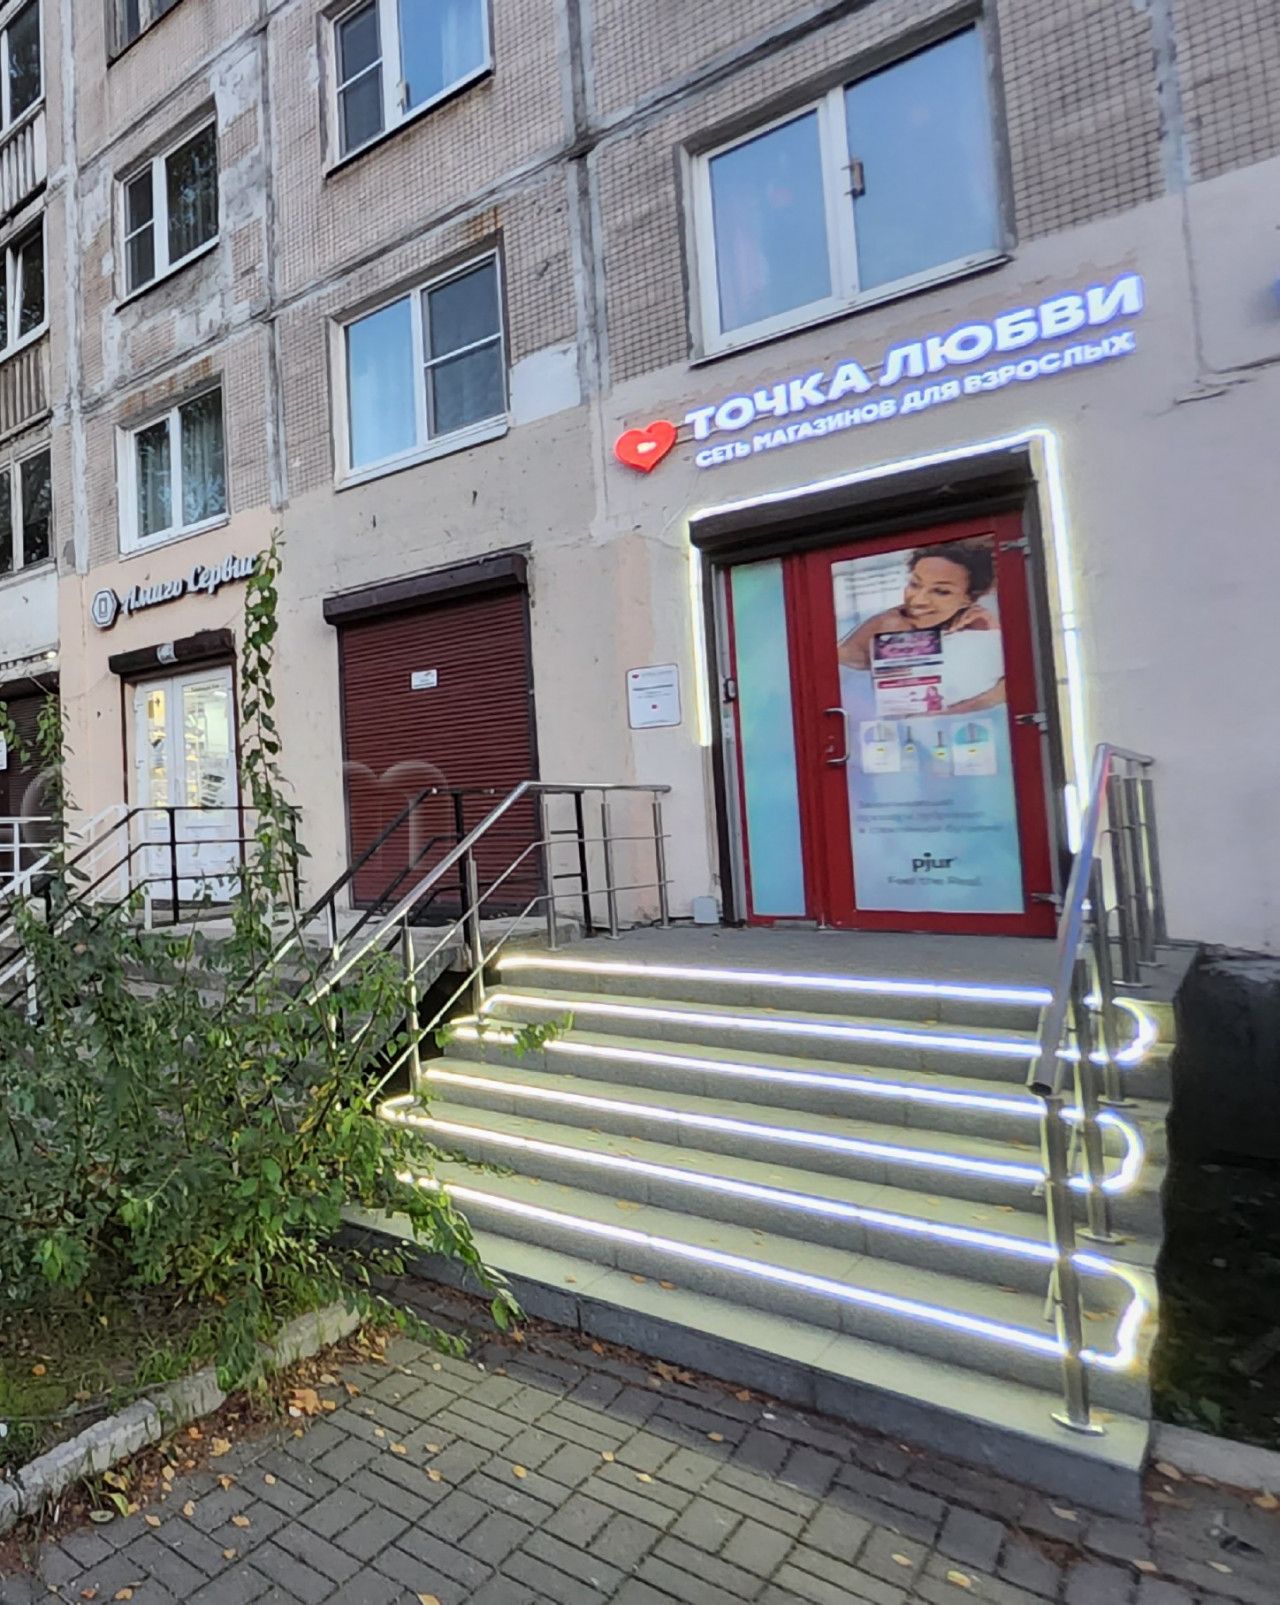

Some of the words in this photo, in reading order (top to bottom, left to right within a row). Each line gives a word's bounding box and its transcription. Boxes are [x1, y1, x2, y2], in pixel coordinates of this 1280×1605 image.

[683, 360, 873, 441] ТОЧКА
[878, 273, 1144, 387] ЛЮБВИ
[695, 441, 752, 468] СЕТЬ
[753, 399, 898, 452] МАГАЗИНОВ
[899, 380, 961, 414] ДЛЯ
[963, 331, 1136, 394] ВЗРОСЛЫХ
[912, 852, 956, 872] pjur
